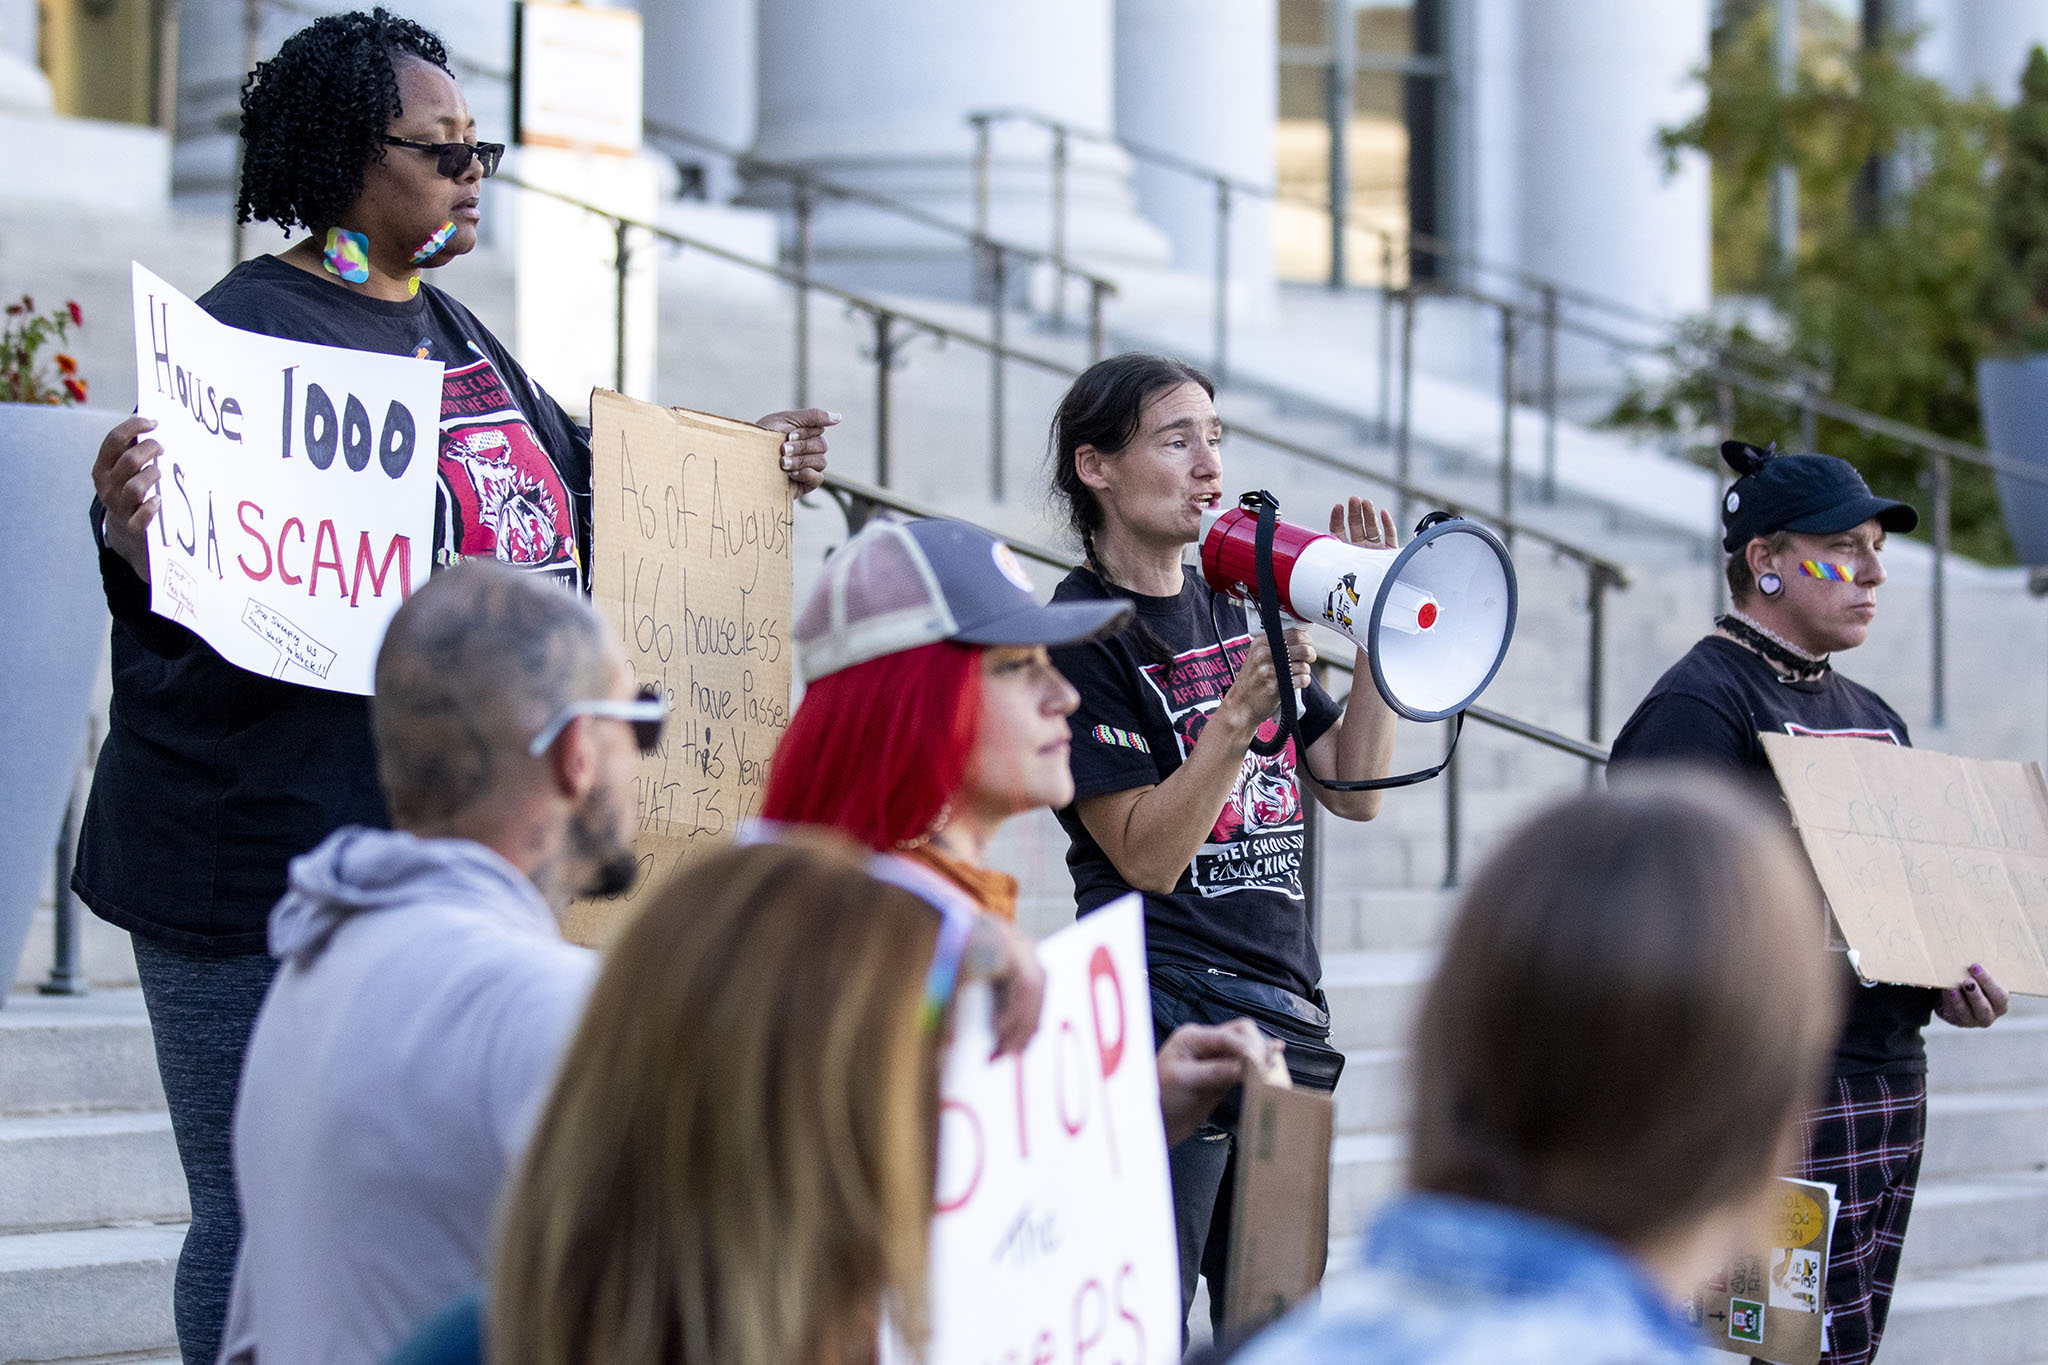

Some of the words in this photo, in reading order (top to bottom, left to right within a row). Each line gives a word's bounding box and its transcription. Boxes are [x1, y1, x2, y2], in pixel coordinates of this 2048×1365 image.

[148, 295, 243, 445] House
[281, 365, 416, 479] 1000
[480, 389, 512, 408] REN
[621, 430, 657, 540] As
[709, 456, 794, 595] August
[207, 490, 224, 580] A
[237, 500, 412, 608] SCAM
[622, 550, 674, 663] 166
[683, 567, 782, 663] houseless
[690, 665, 738, 720] have
[1172, 680, 1215, 706] AFFORD
[632, 776, 681, 837] HAT
[1218, 840, 1250, 862] HEY
